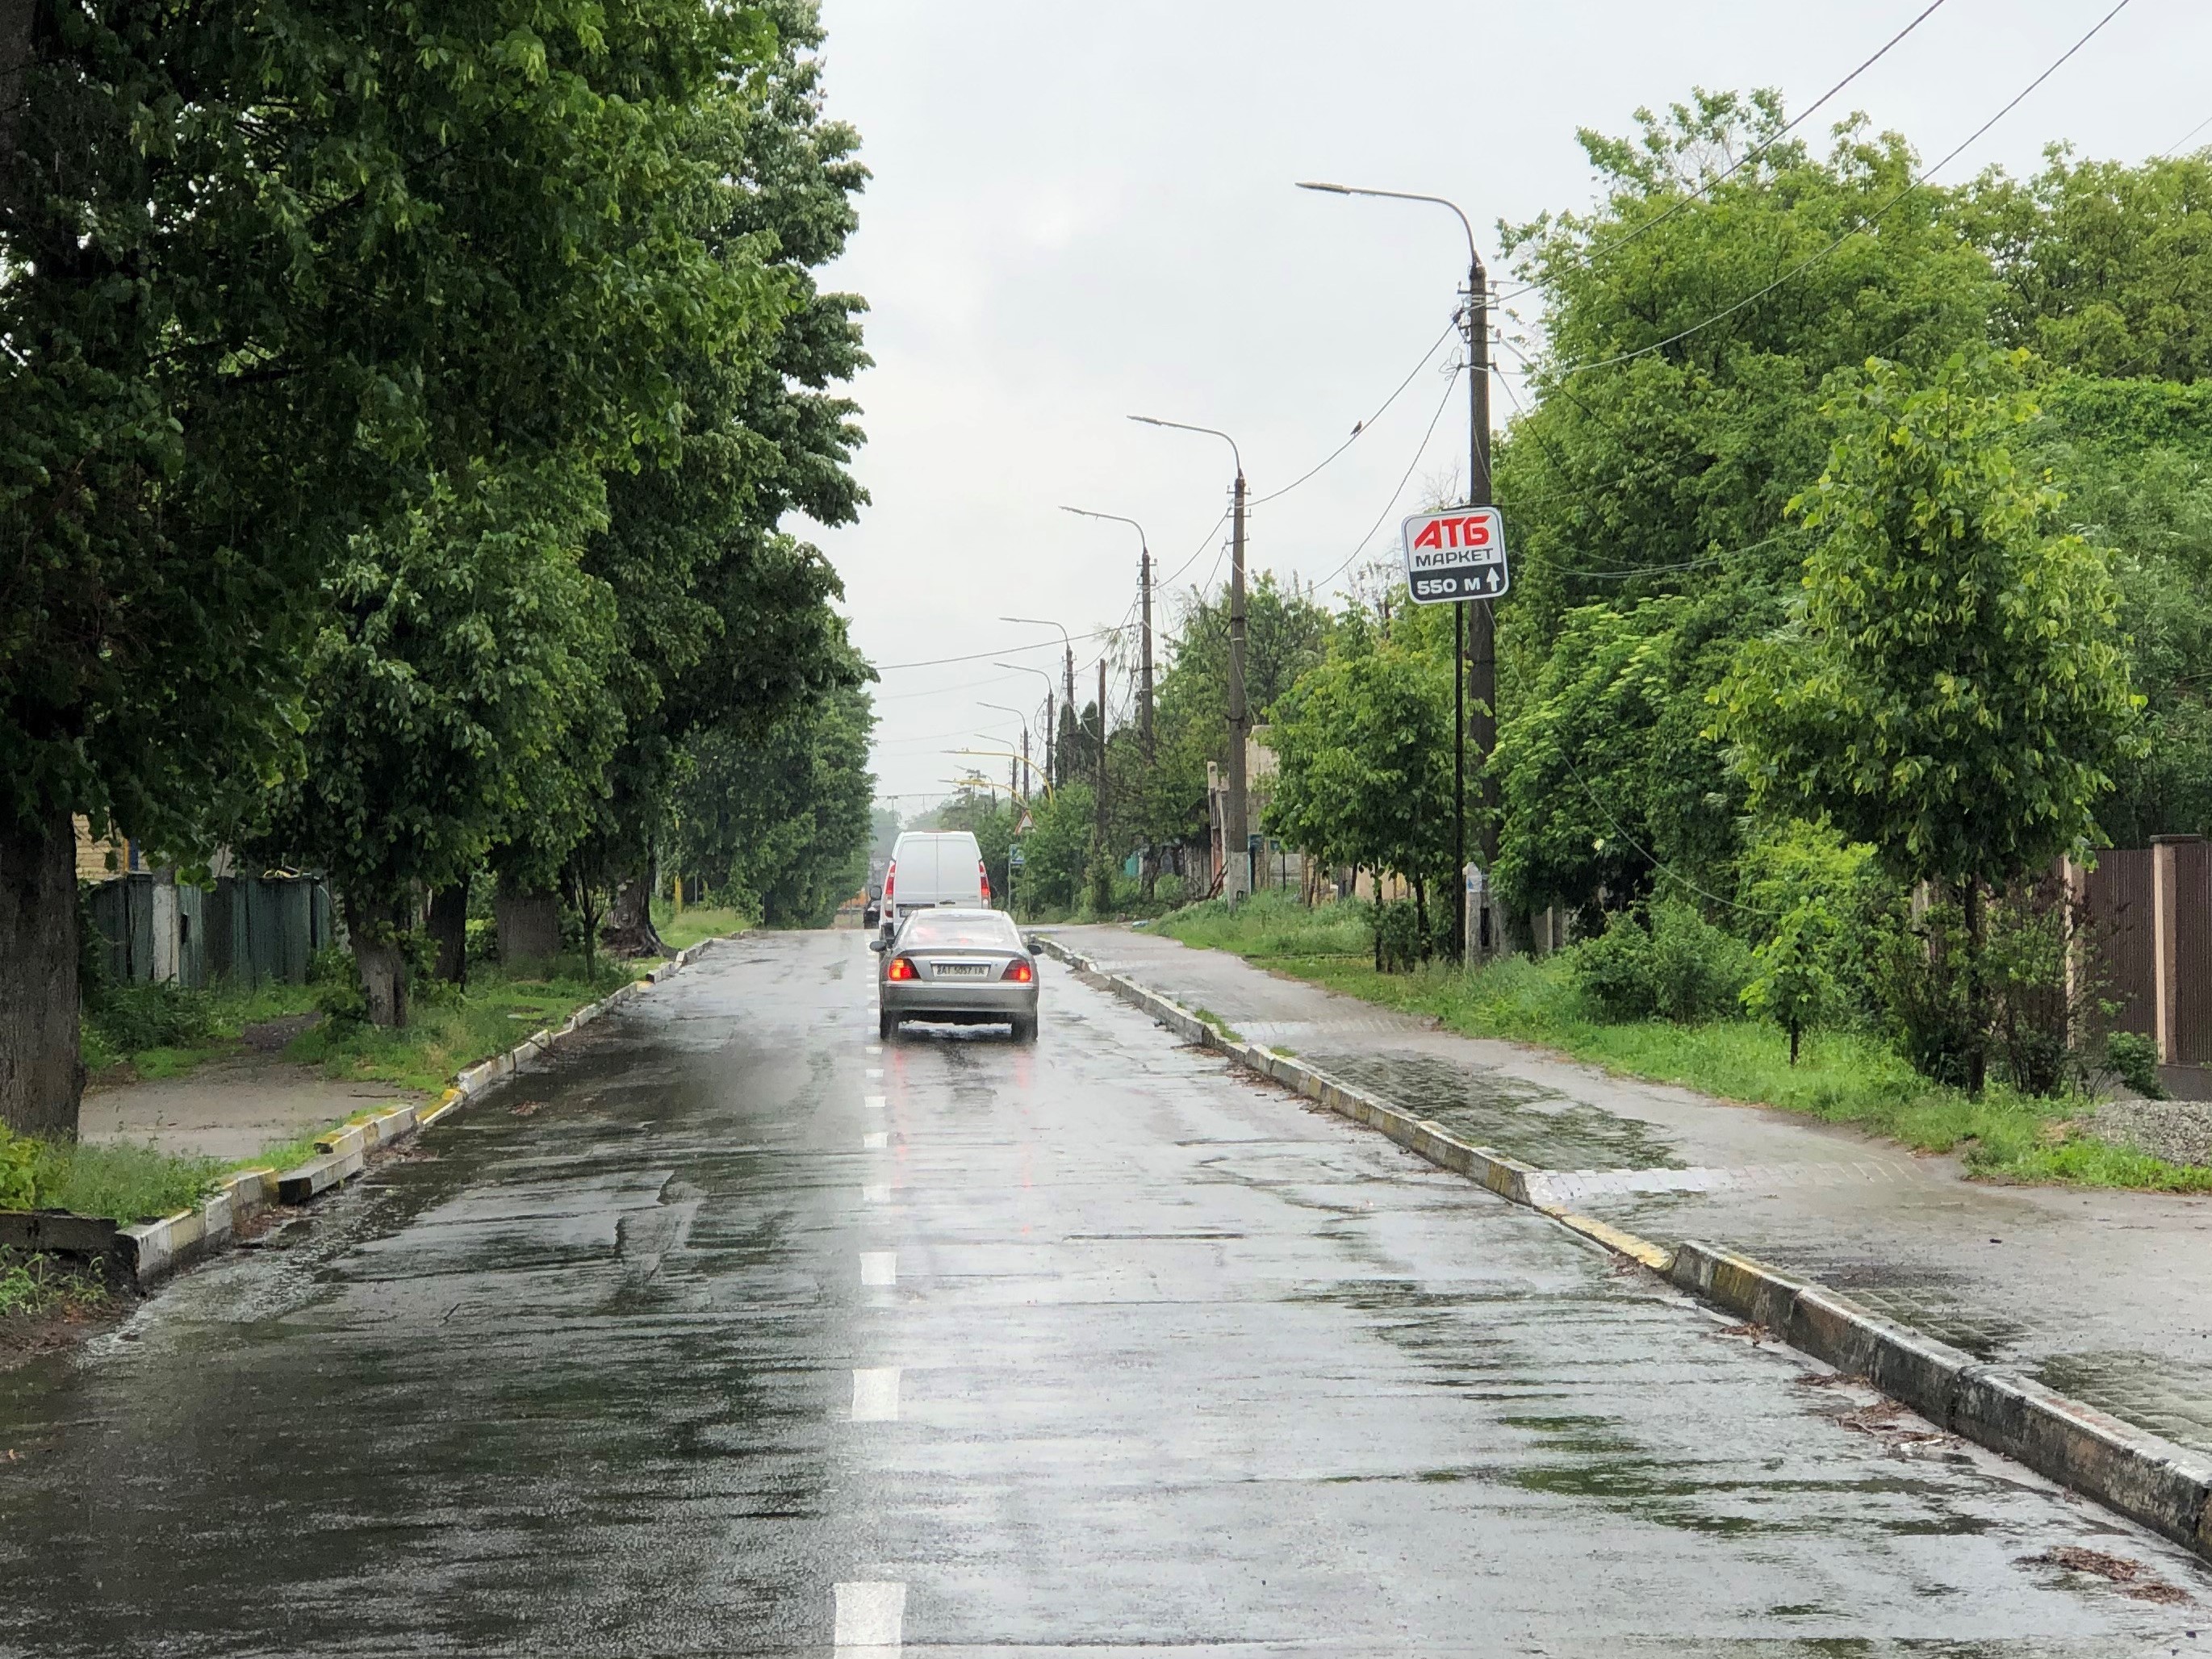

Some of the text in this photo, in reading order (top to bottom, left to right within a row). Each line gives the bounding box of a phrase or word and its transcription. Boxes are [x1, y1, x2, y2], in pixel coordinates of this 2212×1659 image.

[1414, 515, 1491, 550] АТБ
[1415, 547, 1493, 567] МАРКЕТ
[1416, 578, 1457, 595] 550
